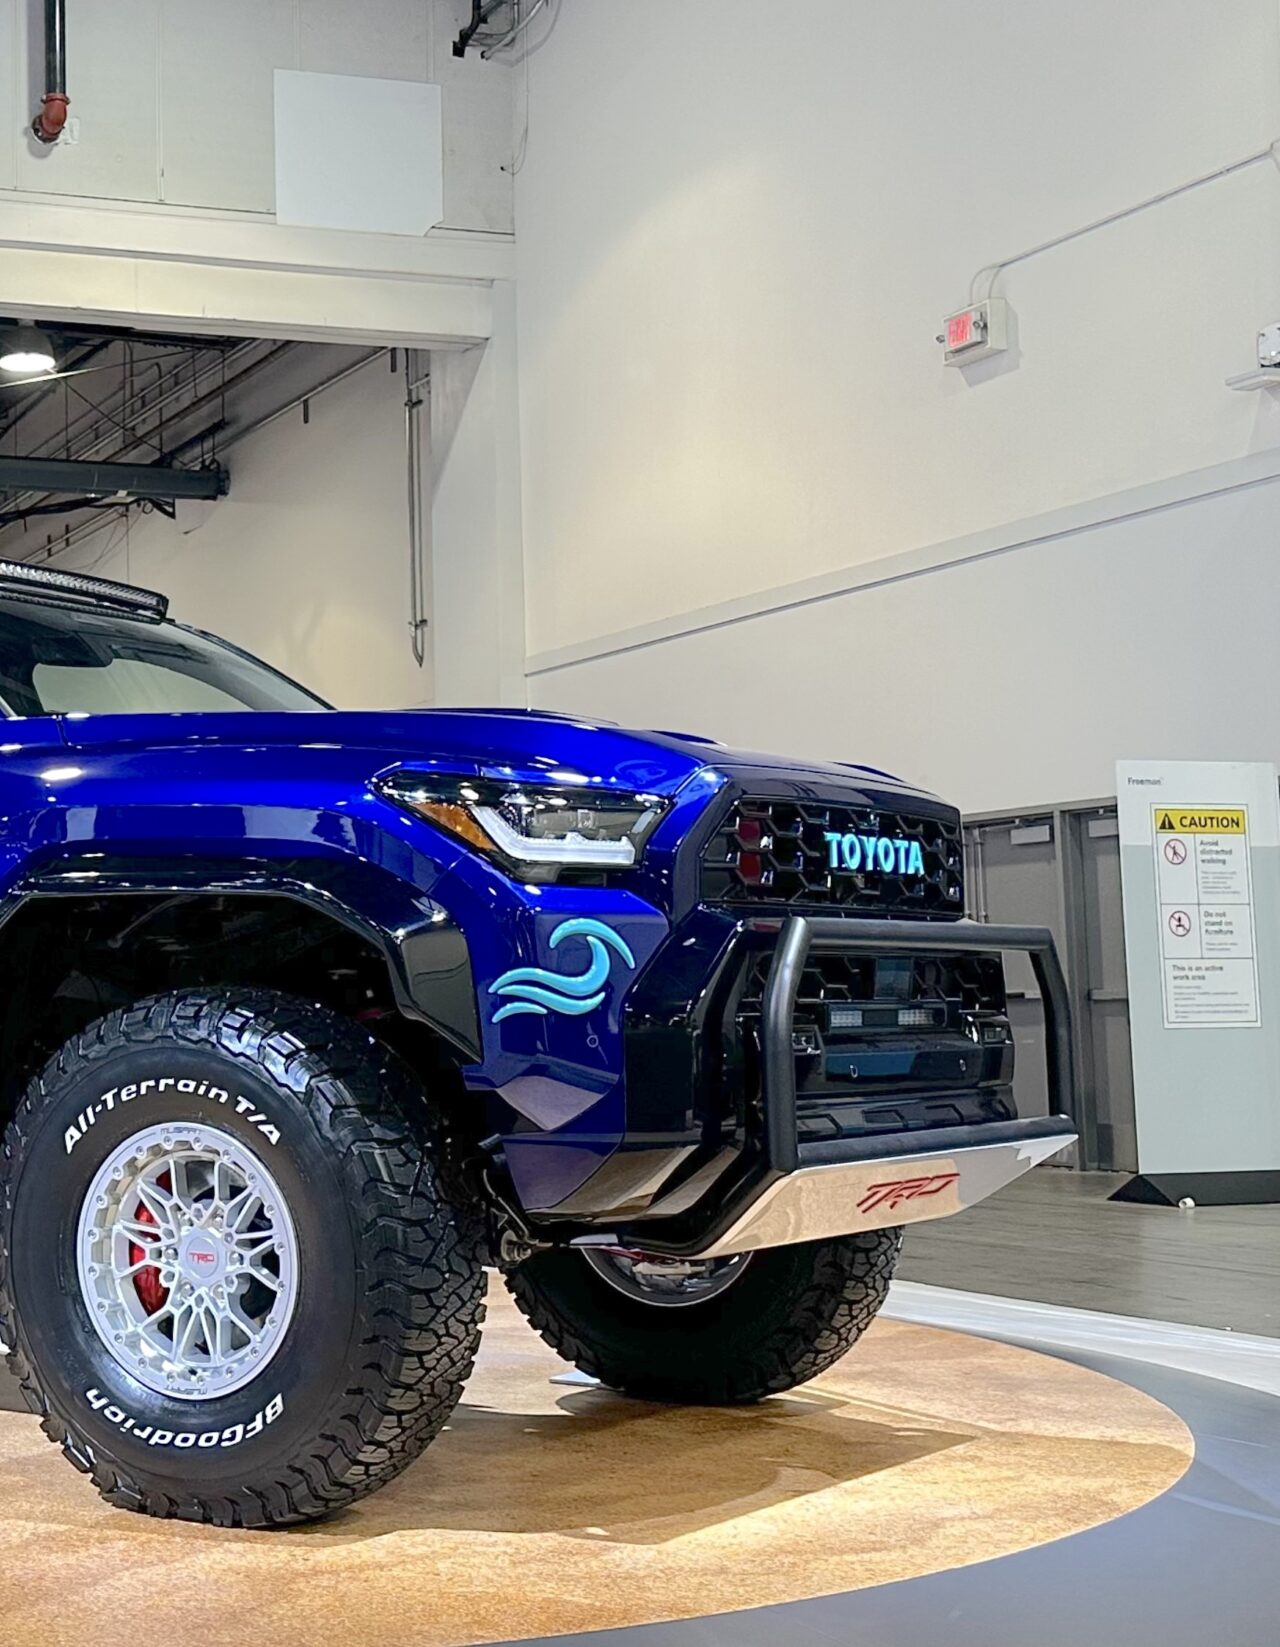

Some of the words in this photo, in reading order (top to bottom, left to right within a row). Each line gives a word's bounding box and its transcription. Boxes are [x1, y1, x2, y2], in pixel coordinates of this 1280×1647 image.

[1127, 777, 1162, 786] Freeman
[1179, 815, 1240, 829] CAUTION
[823, 831, 925, 877] TOYOTA
[62, 1077, 228, 1155] All-Terrain
[235, 1094, 283, 1146] T/A
[188, 1251, 215, 1264] TRD
[84, 1387, 285, 1448] BFGoodrich
